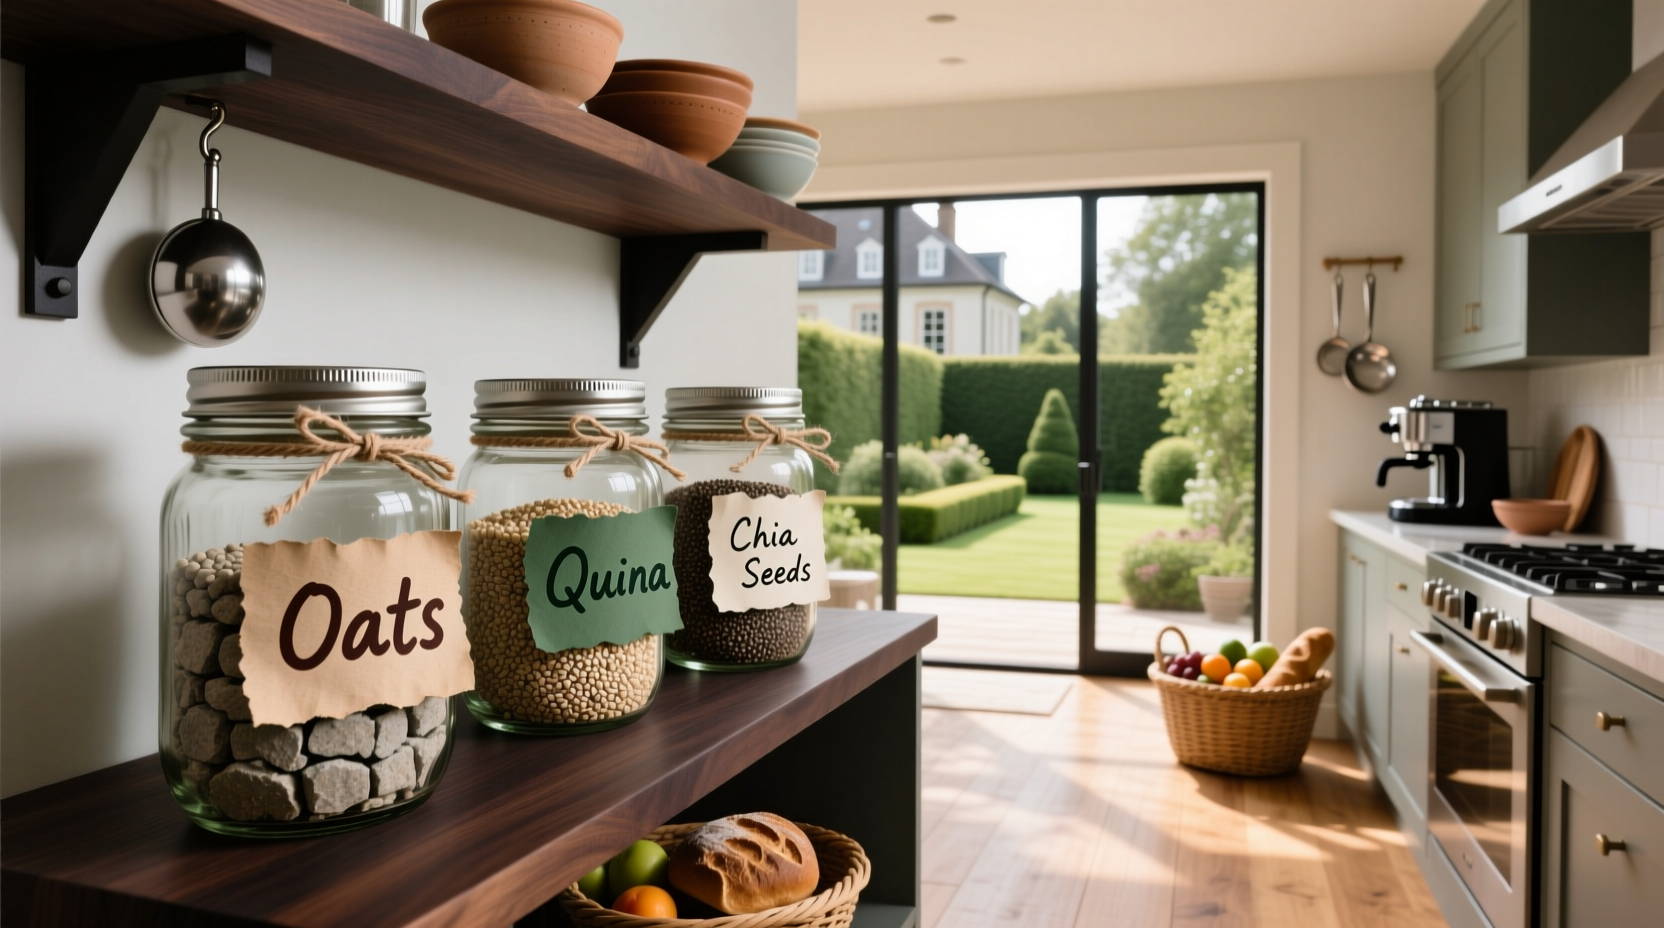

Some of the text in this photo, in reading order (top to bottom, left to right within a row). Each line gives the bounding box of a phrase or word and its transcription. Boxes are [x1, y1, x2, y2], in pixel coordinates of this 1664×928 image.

[730, 516, 798, 552] Chia
[546, 546, 671, 614] Quina
[741, 553, 811, 589] Seeds
[279, 576, 445, 671] Oats
